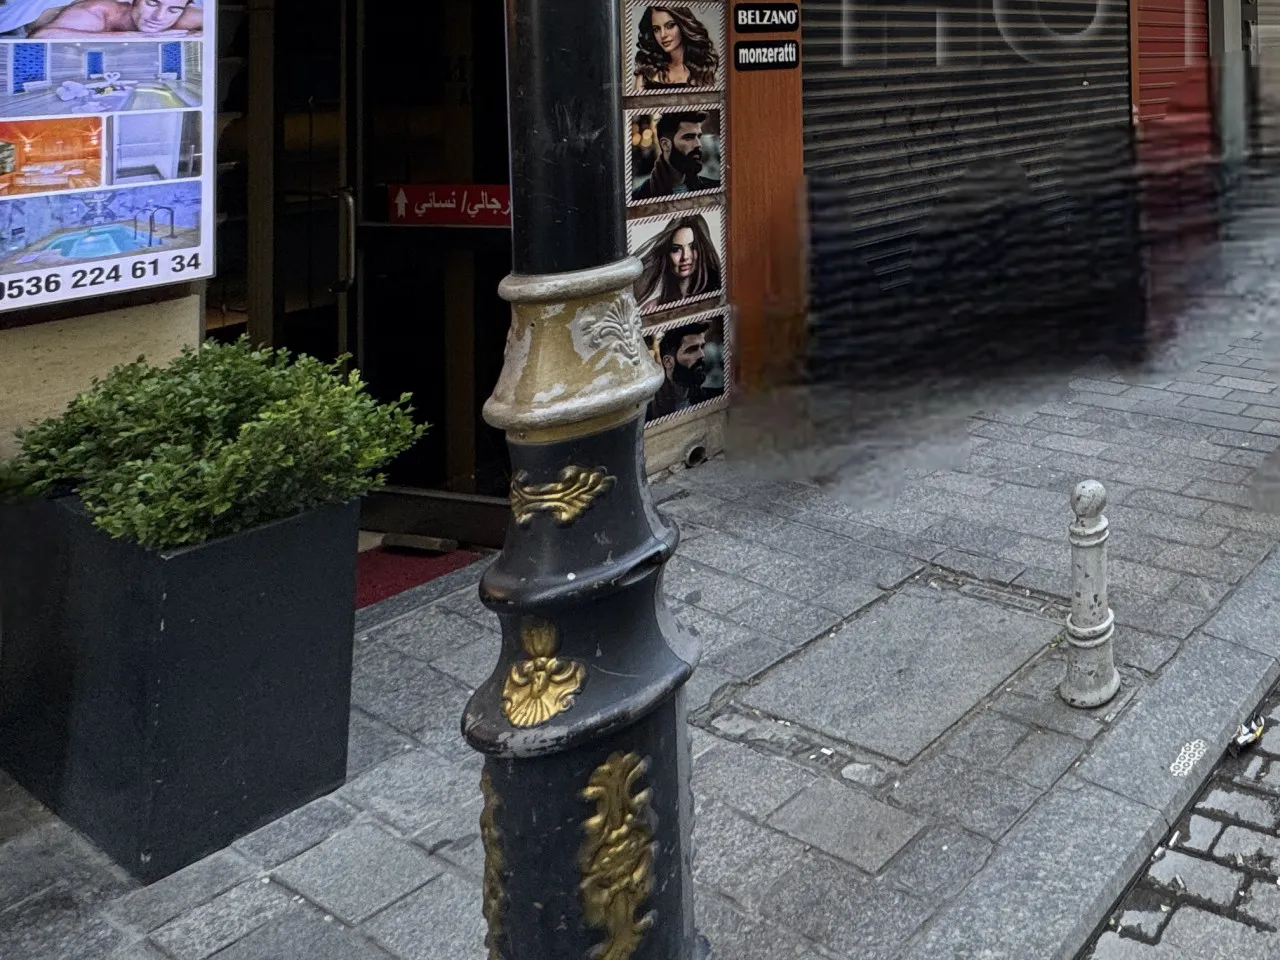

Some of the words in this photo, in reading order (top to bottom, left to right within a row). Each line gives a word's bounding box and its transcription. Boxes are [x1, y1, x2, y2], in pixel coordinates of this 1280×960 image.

[738, 10, 797, 25] BELZANO
[739, 43, 797, 64] monzeratti
[71, 263, 122, 290] 224
[131, 258, 160, 279] 61
[171, 252, 202, 273] 34
